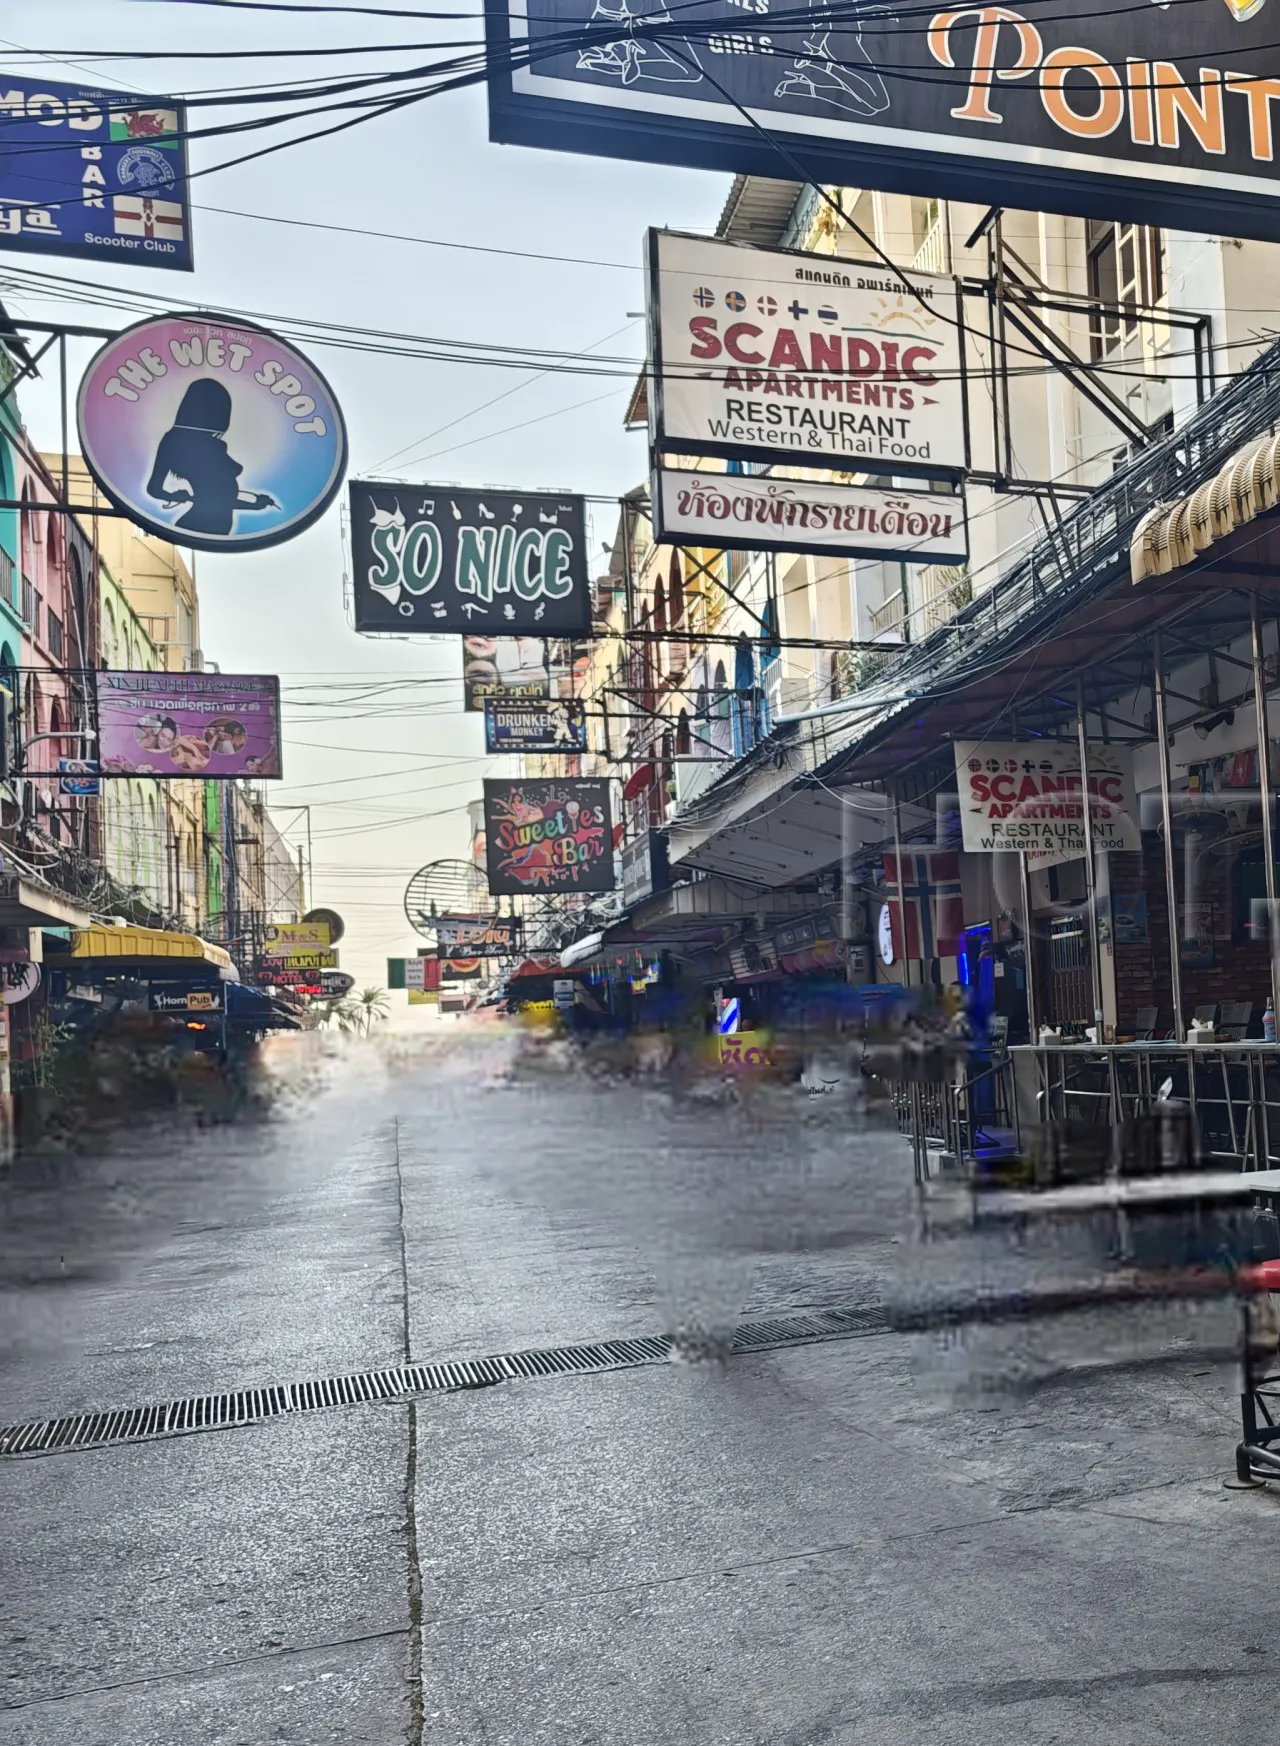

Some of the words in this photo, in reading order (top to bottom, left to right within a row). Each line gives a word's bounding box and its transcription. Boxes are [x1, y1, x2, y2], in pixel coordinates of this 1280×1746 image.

[708, 33, 774, 56] GIRLS
[81, 139, 106, 209] BAR
[84, 232, 140, 249] Scooter
[143, 239, 176, 253] Club
[688, 315, 941, 387] SCANDIC
[103, 347, 168, 403] THE
[168, 336, 253, 373] WET
[253, 359, 328, 438] SPOT
[722, 365, 915, 411] APARTMENTS
[707, 418, 802, 447] Western
[807, 430, 823, 448] &
[826, 430, 873, 454] Thai
[879, 437, 931, 460] Food
[725, 399, 911, 440] RESTAURANT
[677, 480, 952, 539] ห้องพักรายเดือน
[367, 520, 443, 596] SO
[454, 524, 574, 603] NICE
[497, 714, 555, 727] DRUNKEN
[511, 727, 543, 736] MONKEY
[969, 774, 1125, 803] SCANDIC
[553, 836, 604, 866] Bar
[981, 837, 1039, 849] Western
[1044, 837, 1054, 849] &
[1057, 837, 1086, 849] Tha
[1093, 838, 1124, 849] Food
